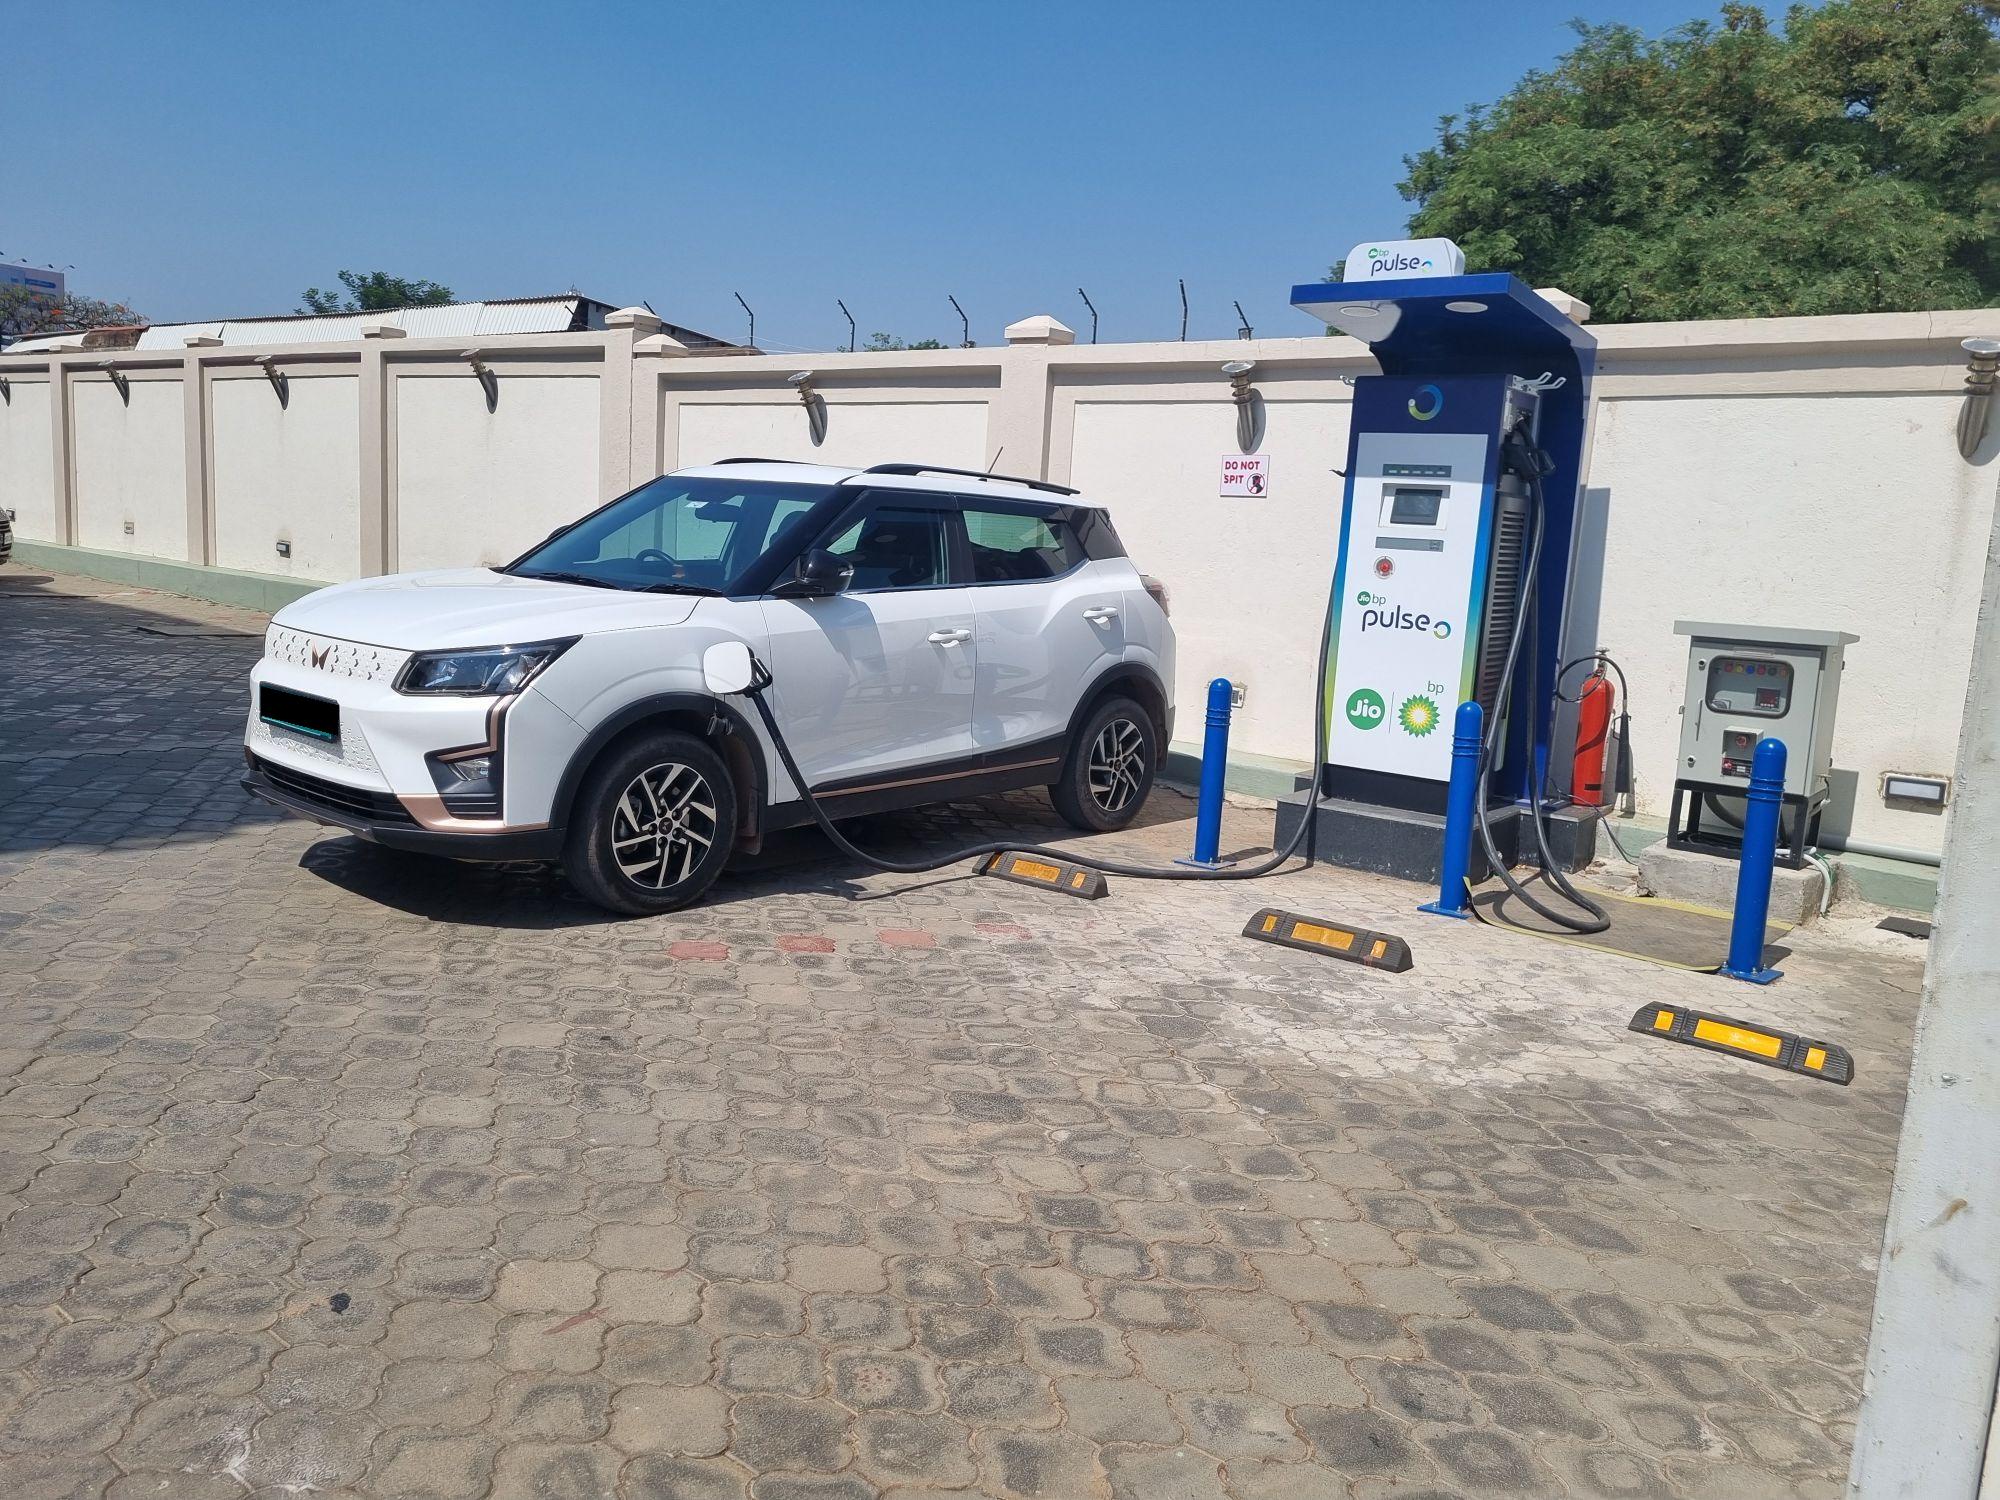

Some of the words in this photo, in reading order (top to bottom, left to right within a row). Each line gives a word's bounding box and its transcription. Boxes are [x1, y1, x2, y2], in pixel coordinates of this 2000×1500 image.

[1370, 253, 1420, 277] pulse
[1225, 461, 1238, 470] DO
[1240, 461, 1260, 470] NOT
[1223, 474, 1244, 484] SPIT
[1371, 593, 1387, 606] bp
[1361, 604, 1431, 632] pulse
[1427, 680, 1444, 695] bp
[1350, 698, 1381, 719] Jio
